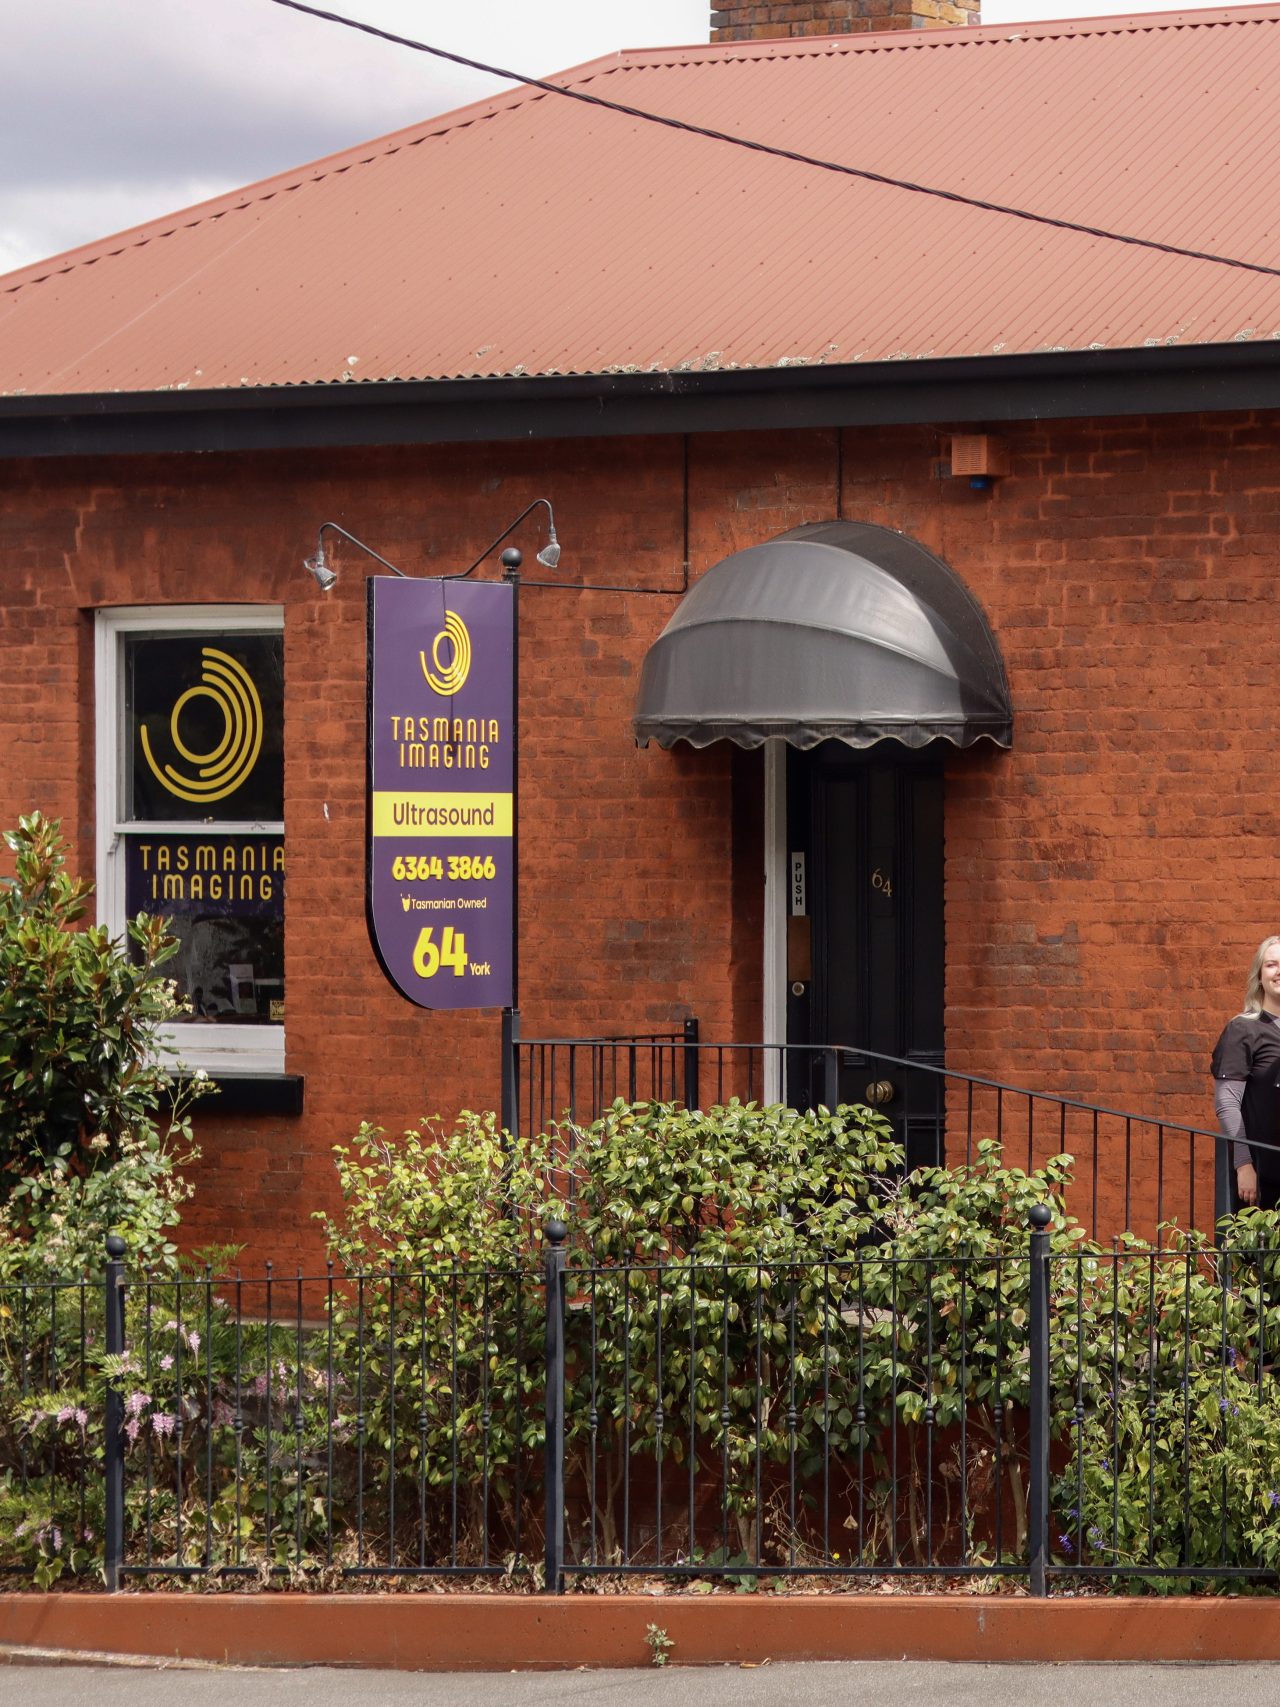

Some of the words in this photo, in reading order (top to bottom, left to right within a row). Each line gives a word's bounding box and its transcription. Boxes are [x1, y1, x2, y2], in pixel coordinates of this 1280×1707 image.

[390, 716, 499, 743] TASMANIA
[400, 743, 489, 769] IMAGING
[393, 801, 494, 825] Ultrasound
[139, 845, 285, 871] TASMANIA
[392, 856, 443, 880] 6364
[447, 855, 496, 880] 3866
[152, 874, 273, 900] IMAGING
[794, 862, 803, 905] PUSH
[871, 867, 892, 897] 64
[411, 897, 456, 910] Tasmanian
[457, 897, 487, 909] Owned
[412, 926, 468, 978] 64
[469, 961, 491, 976] York
